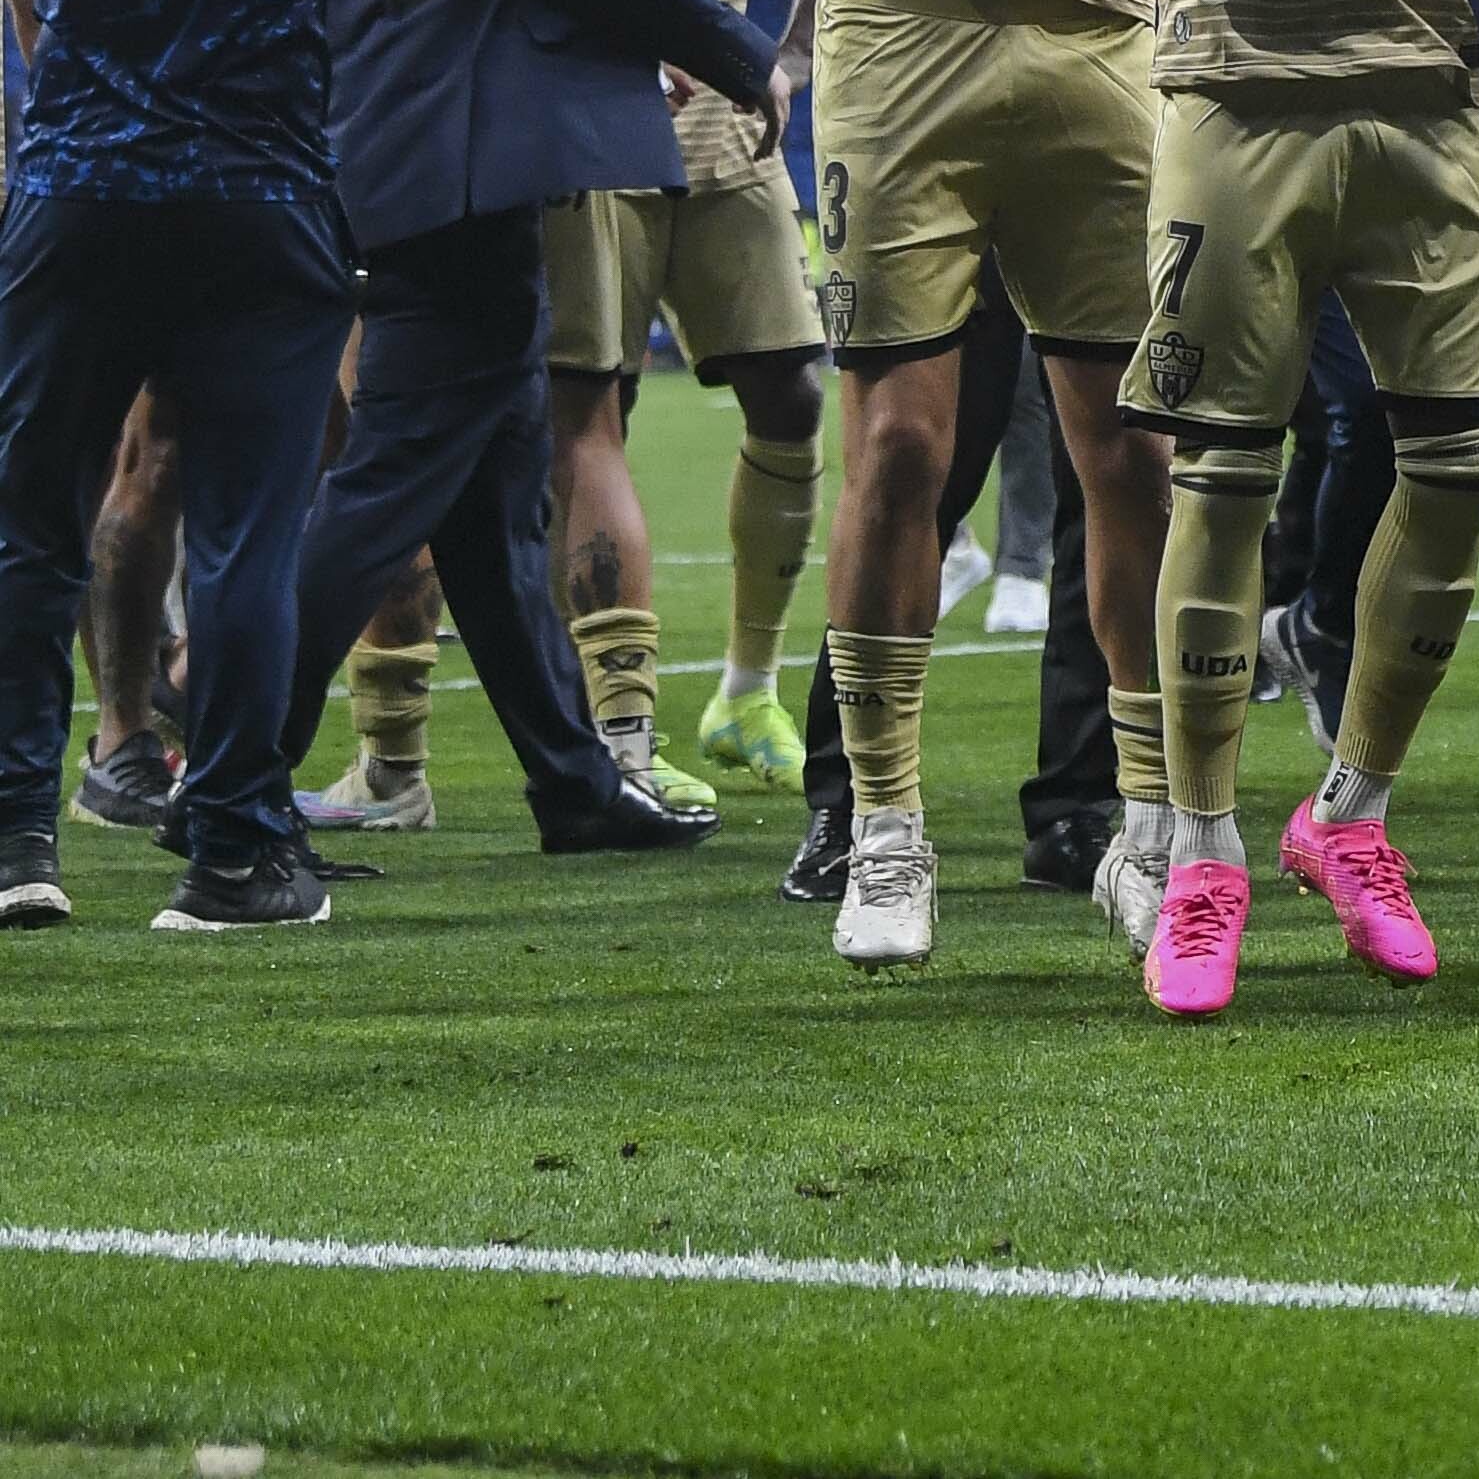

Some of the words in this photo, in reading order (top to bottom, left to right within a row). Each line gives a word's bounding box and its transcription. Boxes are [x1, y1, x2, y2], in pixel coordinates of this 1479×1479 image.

[823, 161, 850, 255] 3
[1161, 219, 1206, 319] 7
[1153, 345, 1164, 357] U
[1181, 650, 1248, 677] UDA
